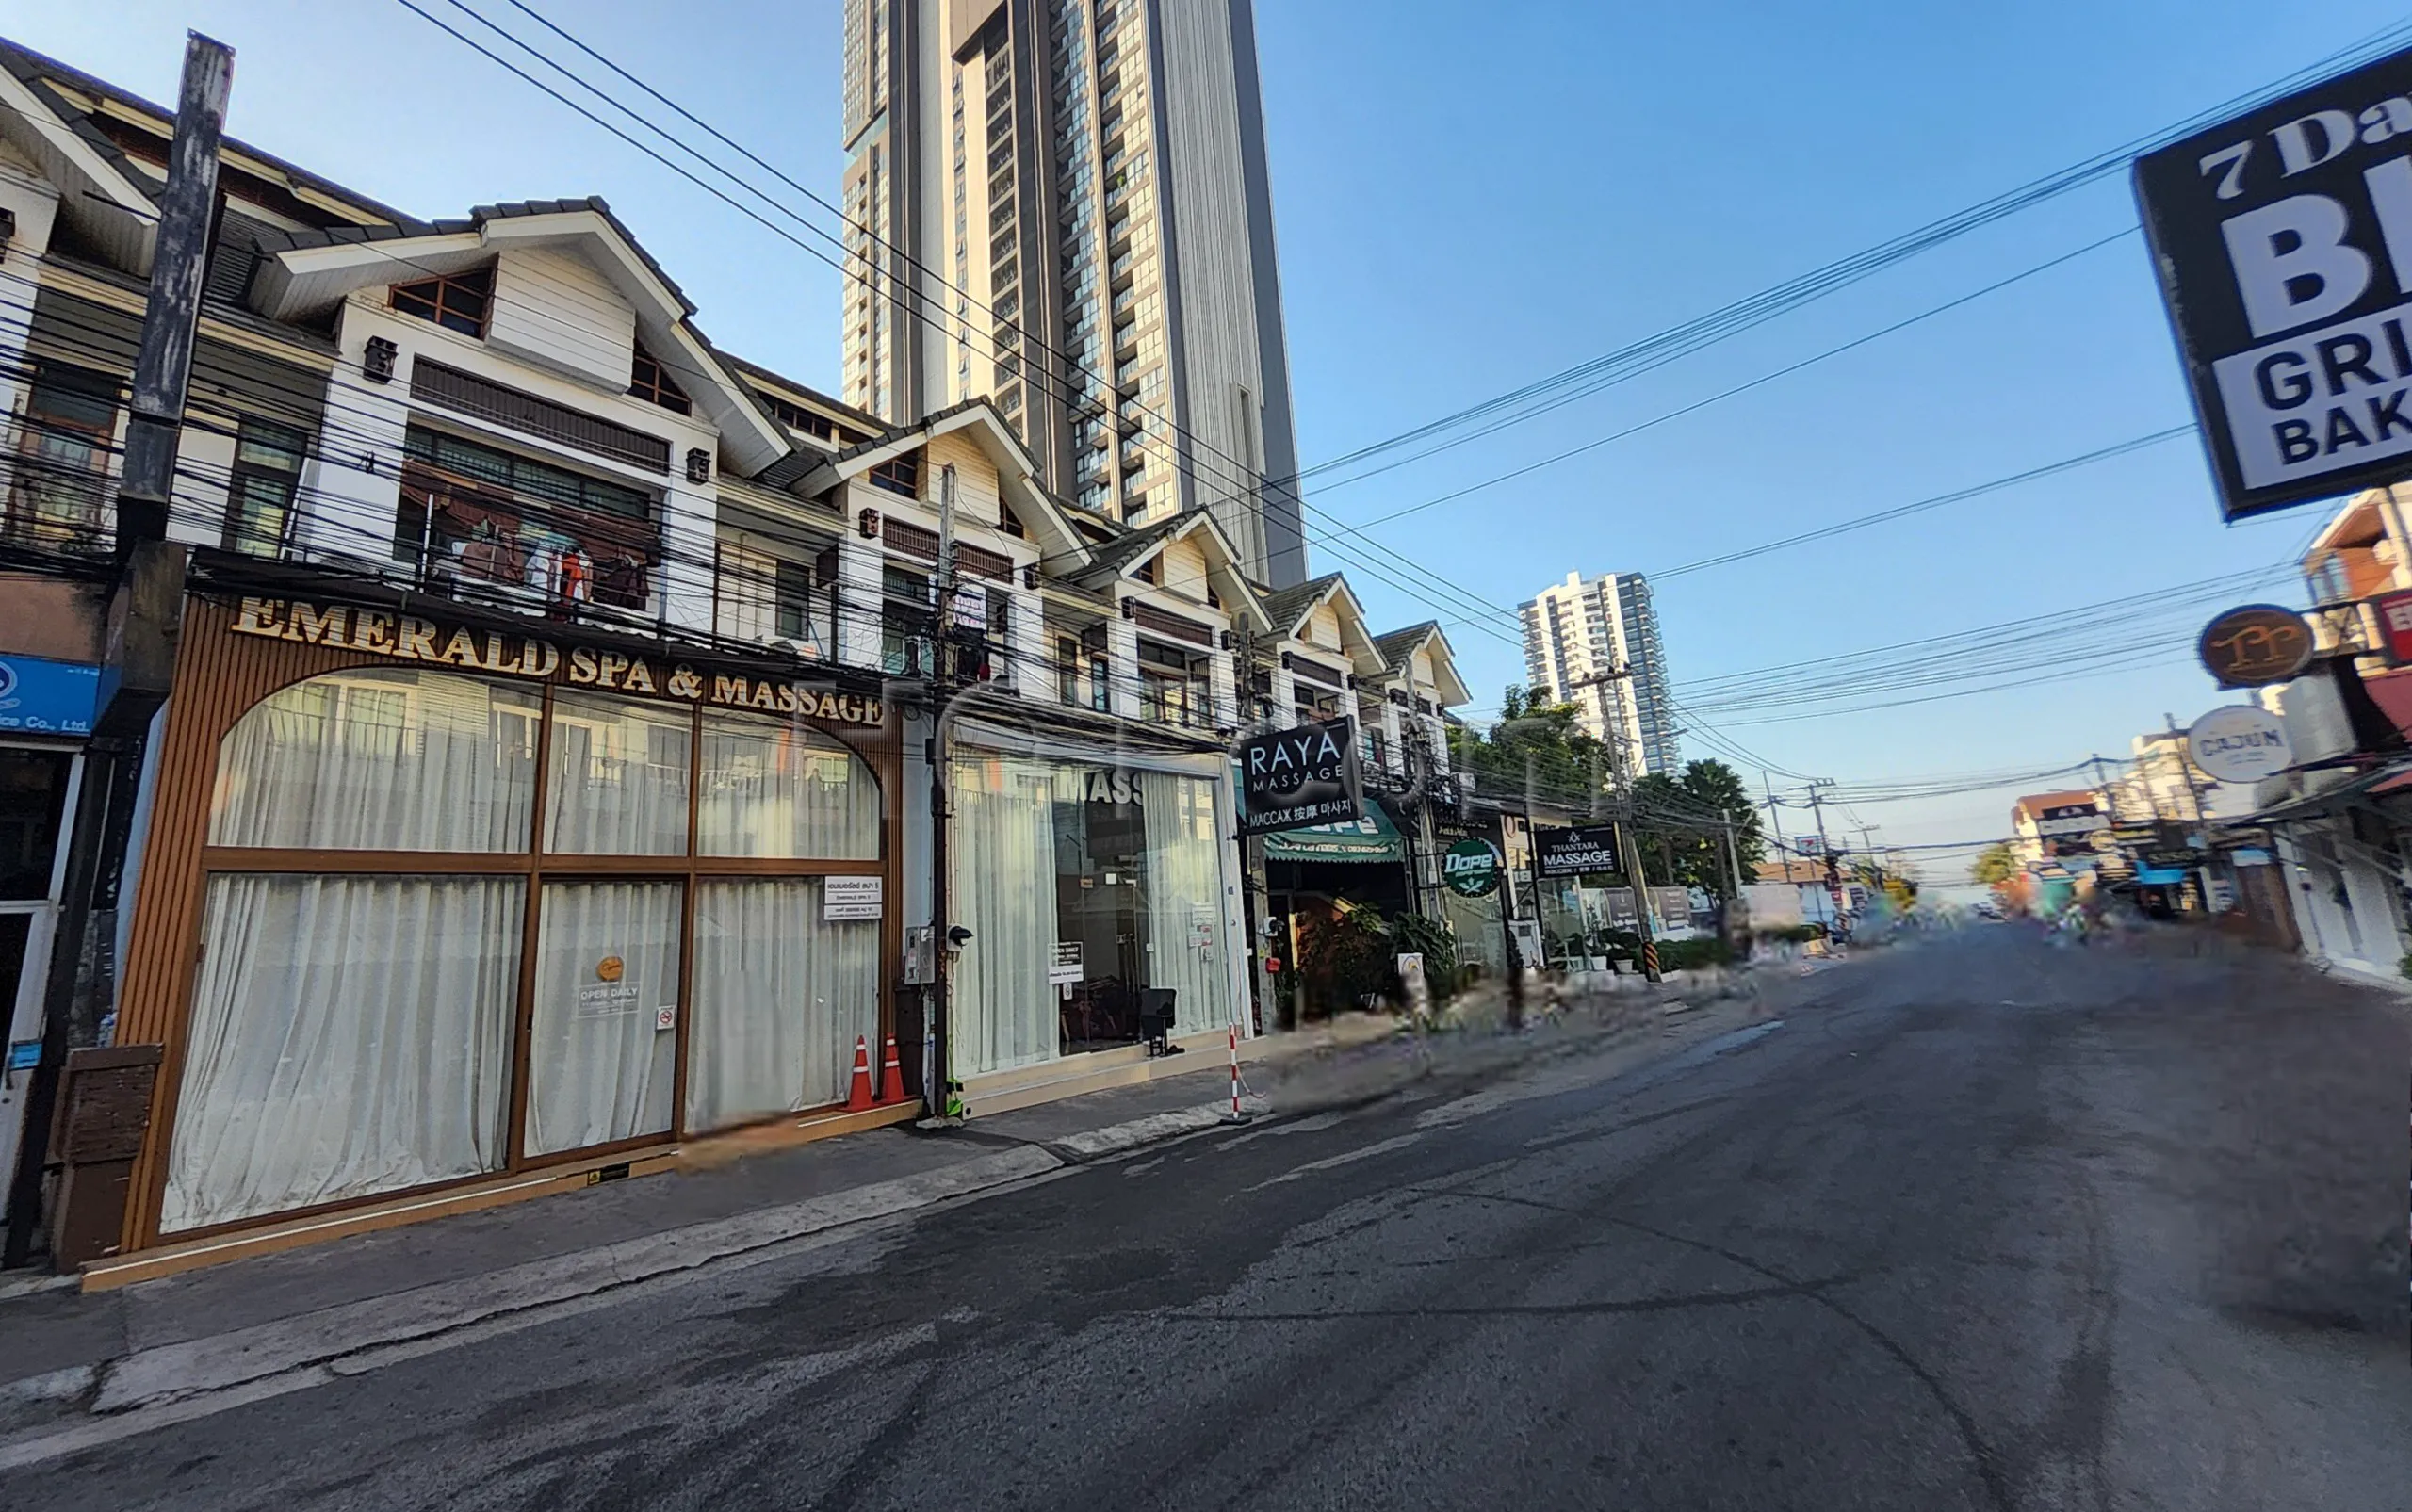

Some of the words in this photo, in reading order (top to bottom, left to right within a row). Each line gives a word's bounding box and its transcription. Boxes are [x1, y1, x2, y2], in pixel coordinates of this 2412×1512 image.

[2199, 140, 2254, 200] 7
[231, 595, 561, 677] EMERALD
[568, 645, 657, 694] SPA
[668, 662, 703, 700] &
[710, 673, 884, 726] MASSAGE
[1250, 731, 1341, 776] RAYA
[1253, 764, 1344, 792] MASSAGE
[1321, 799, 1352, 818] 마사지
[1543, 850, 1612, 866] MASSAGE
[1551, 841, 1600, 853] THANTARA
[580, 988, 608, 1000] OPEN
[611, 986, 638, 997] DAILY
